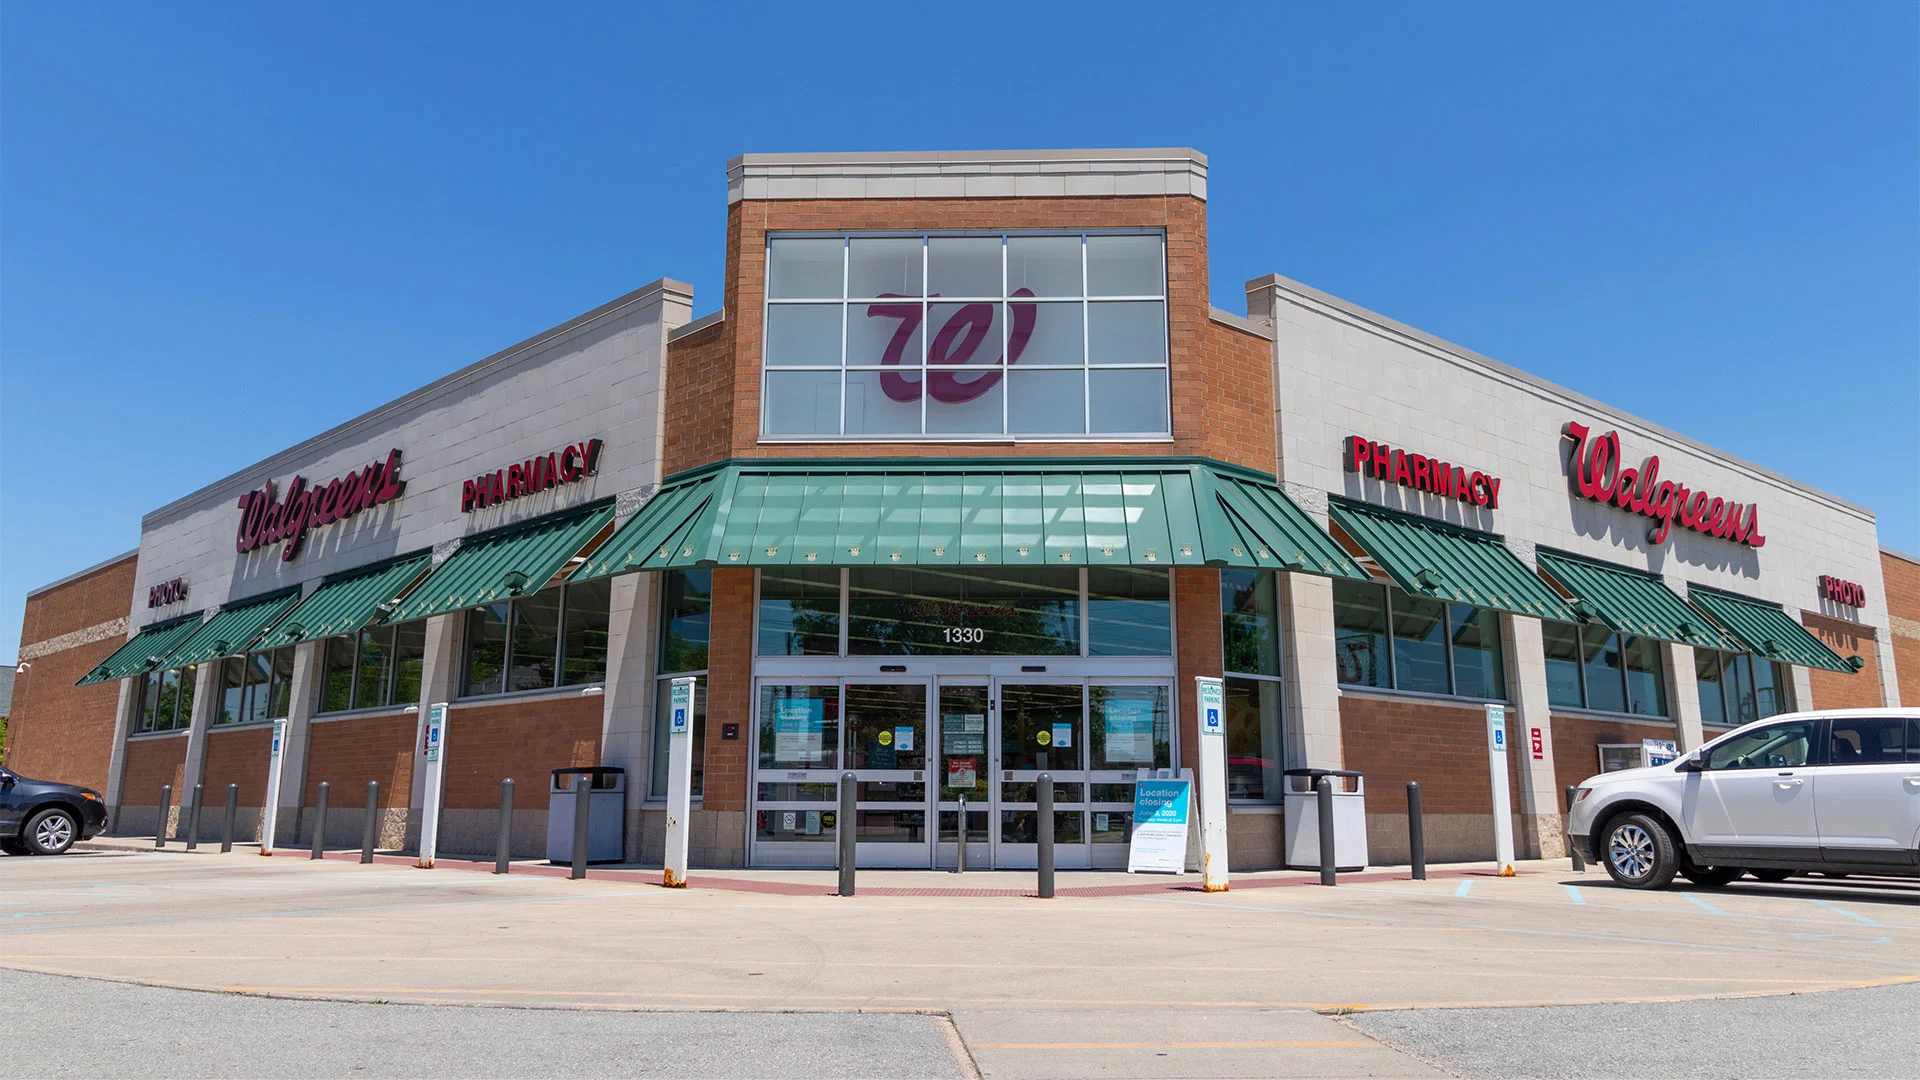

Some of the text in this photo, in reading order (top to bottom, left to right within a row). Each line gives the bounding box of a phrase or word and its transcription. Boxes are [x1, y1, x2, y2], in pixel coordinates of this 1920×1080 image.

[461, 438, 603, 513] PHARMACY
[1345, 435, 1501, 510] PHARMACY
[1560, 421, 1766, 546] Walgreens
[236, 448, 407, 562] Walgreens
[148, 577, 188, 608] PHOTO
[1818, 575, 1866, 608] PHOTO
[943, 628, 984, 643] 1330
[780, 706, 813, 714] Location
[1139, 798, 1172, 808] closing
[1140, 788, 1179, 797] Location
